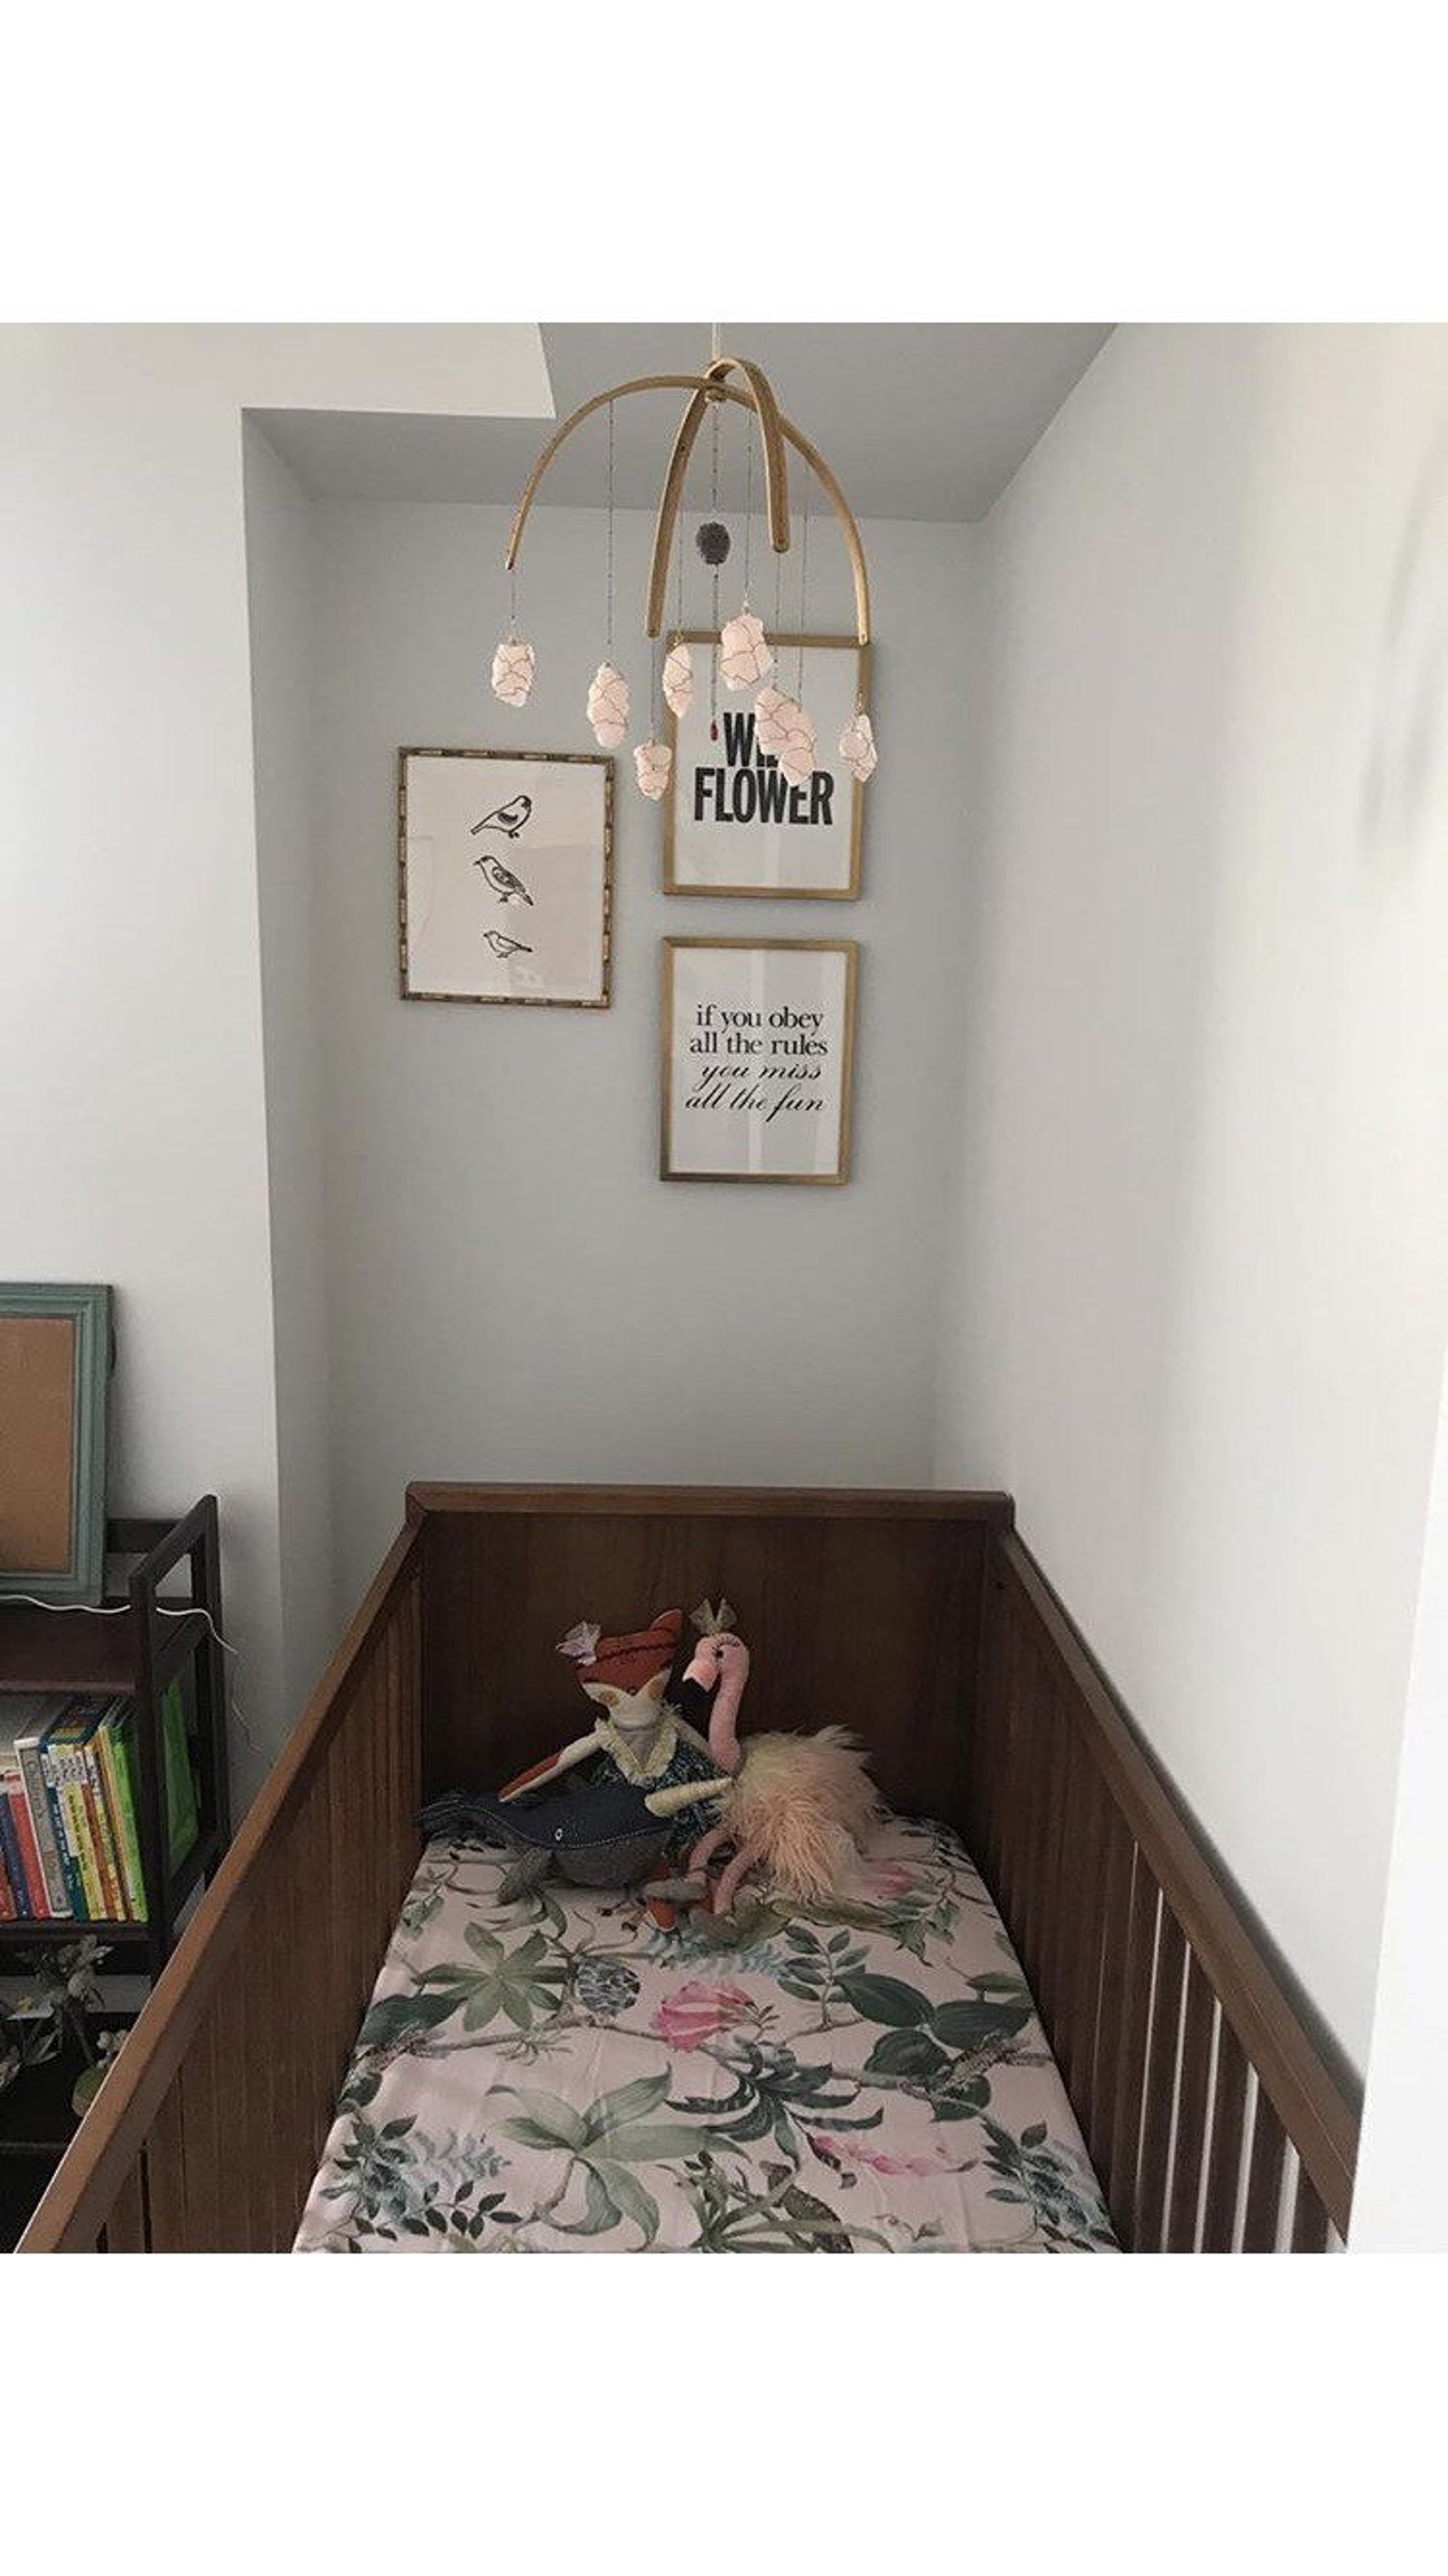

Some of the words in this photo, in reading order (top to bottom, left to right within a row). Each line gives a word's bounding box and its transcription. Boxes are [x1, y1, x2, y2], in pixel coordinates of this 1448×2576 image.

[695, 766, 834, 825] FLOWER
[697, 1004, 718, 1027] if
[720, 1011, 762, 1034] you
[768, 1005, 824, 1037] obey
[689, 1030, 718, 1054] all
[727, 1032, 763, 1055] the
[771, 1033, 829, 1057] rules
[693, 1065, 750, 1091] you
[759, 1063, 822, 1081] miss
[685, 1082, 732, 1110] all
[729, 1083, 769, 1110] the
[765, 1083, 824, 1123] fun
